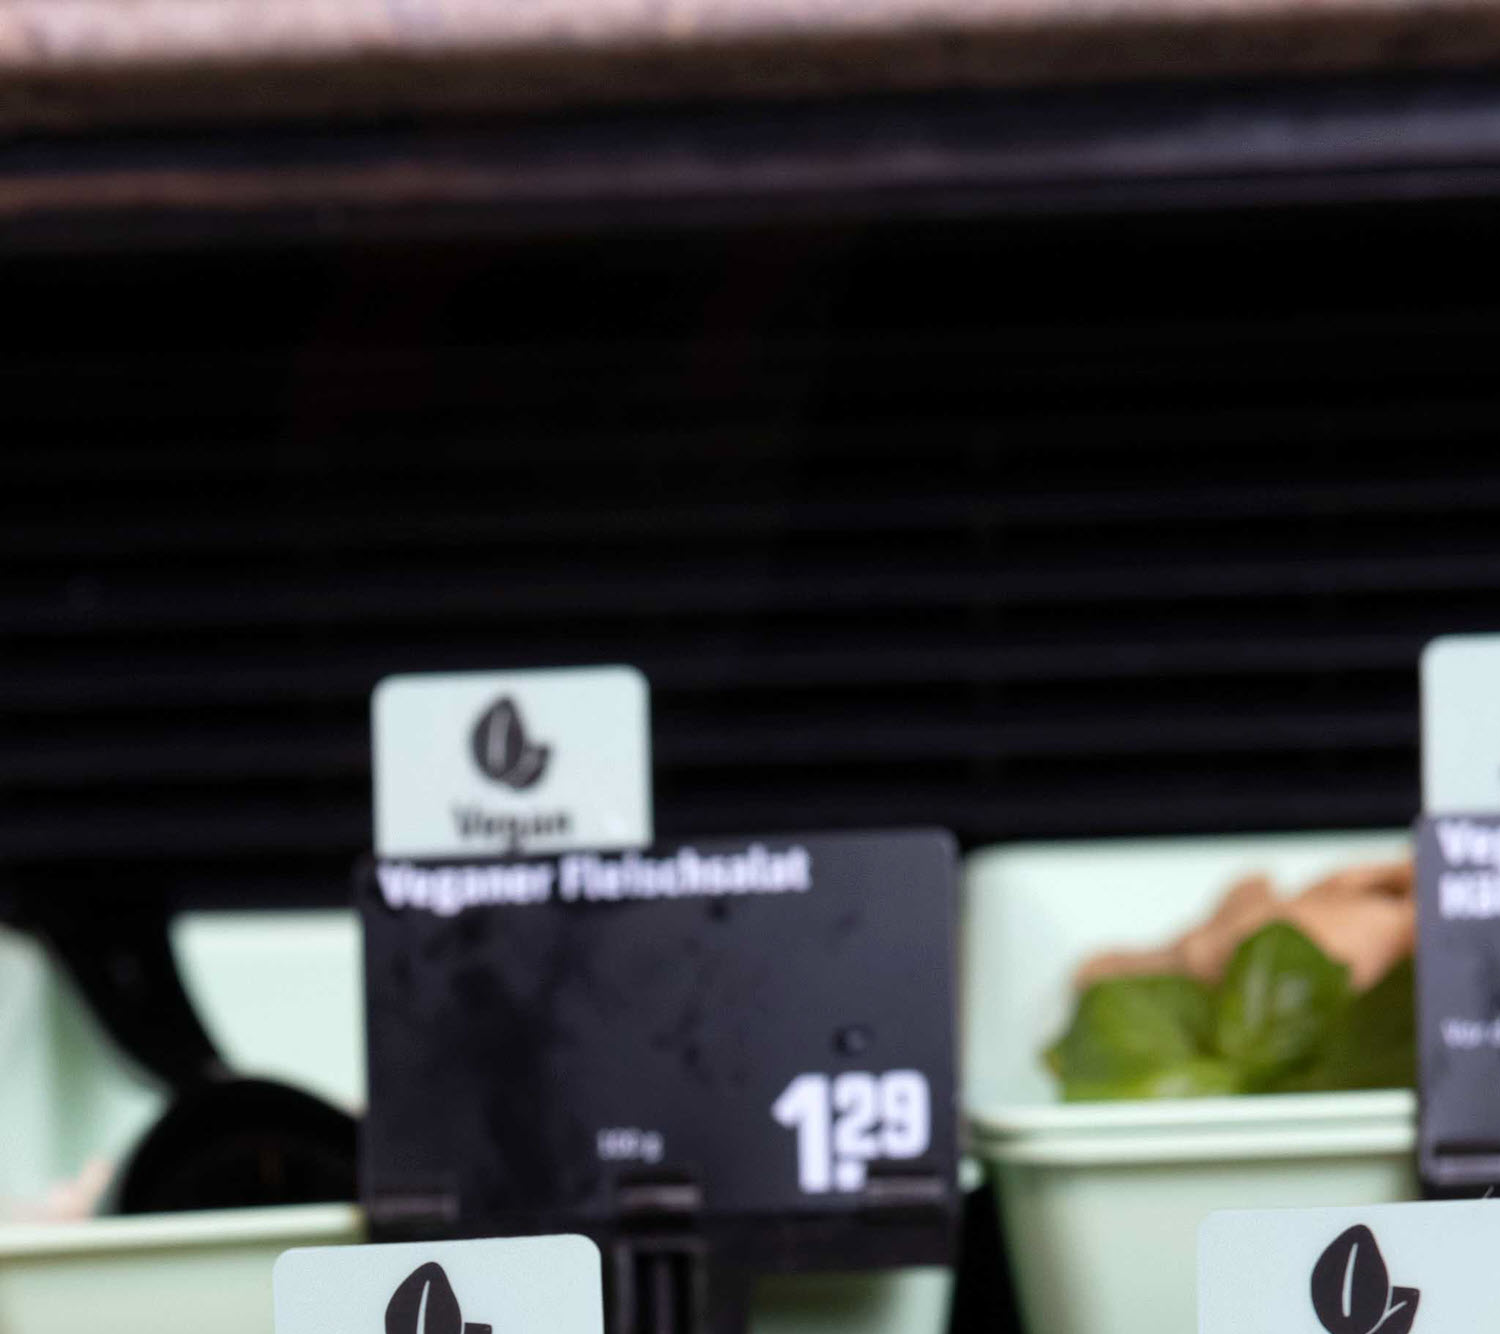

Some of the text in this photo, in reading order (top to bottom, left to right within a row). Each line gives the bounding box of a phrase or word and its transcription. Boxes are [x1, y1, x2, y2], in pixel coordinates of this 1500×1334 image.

[453, 806, 572, 852] Vegan
[378, 845, 811, 916] Veganer Fleischsalat
[772, 1070, 931, 1194] 1.29
